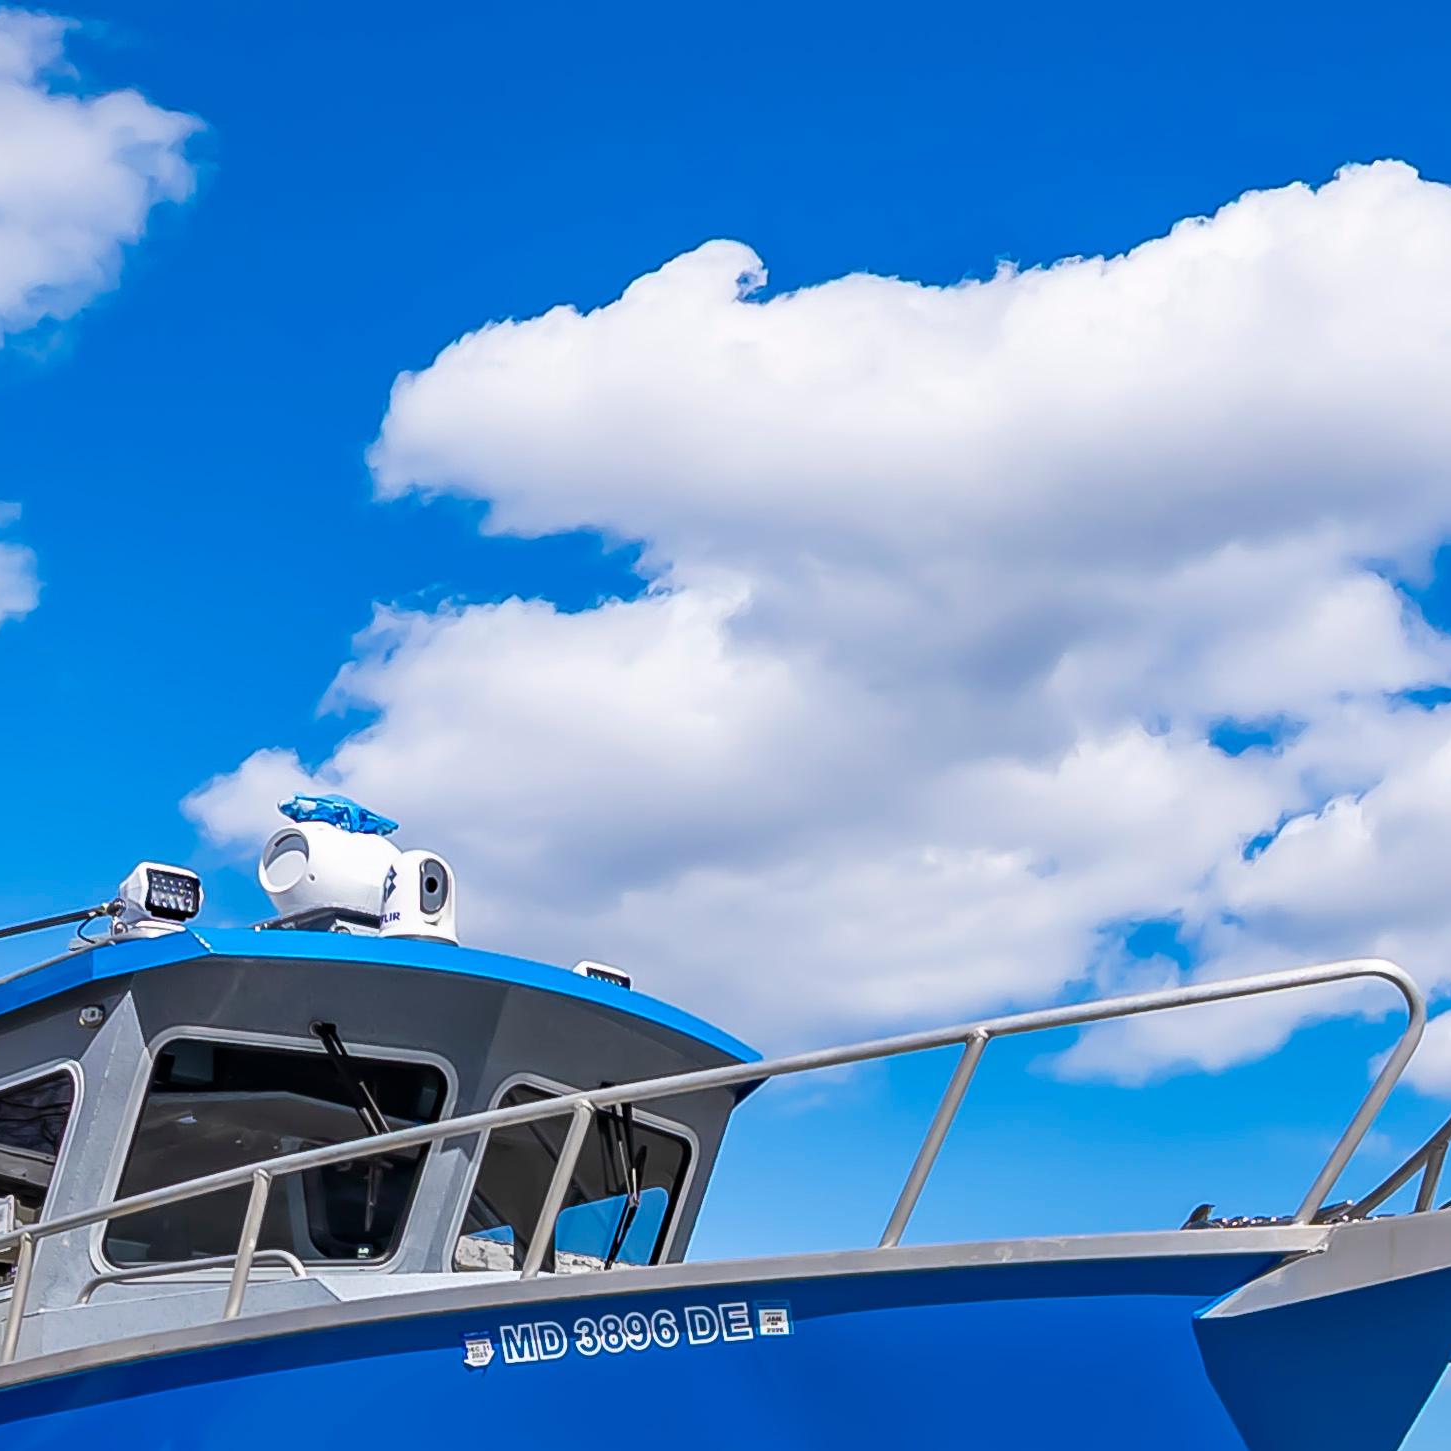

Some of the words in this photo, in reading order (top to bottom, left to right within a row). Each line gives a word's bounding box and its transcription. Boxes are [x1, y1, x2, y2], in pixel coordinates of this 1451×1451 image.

[500, 1322, 568, 1364] MD
[575, 1309, 679, 1356] 3896
[684, 1302, 753, 1345] DE
